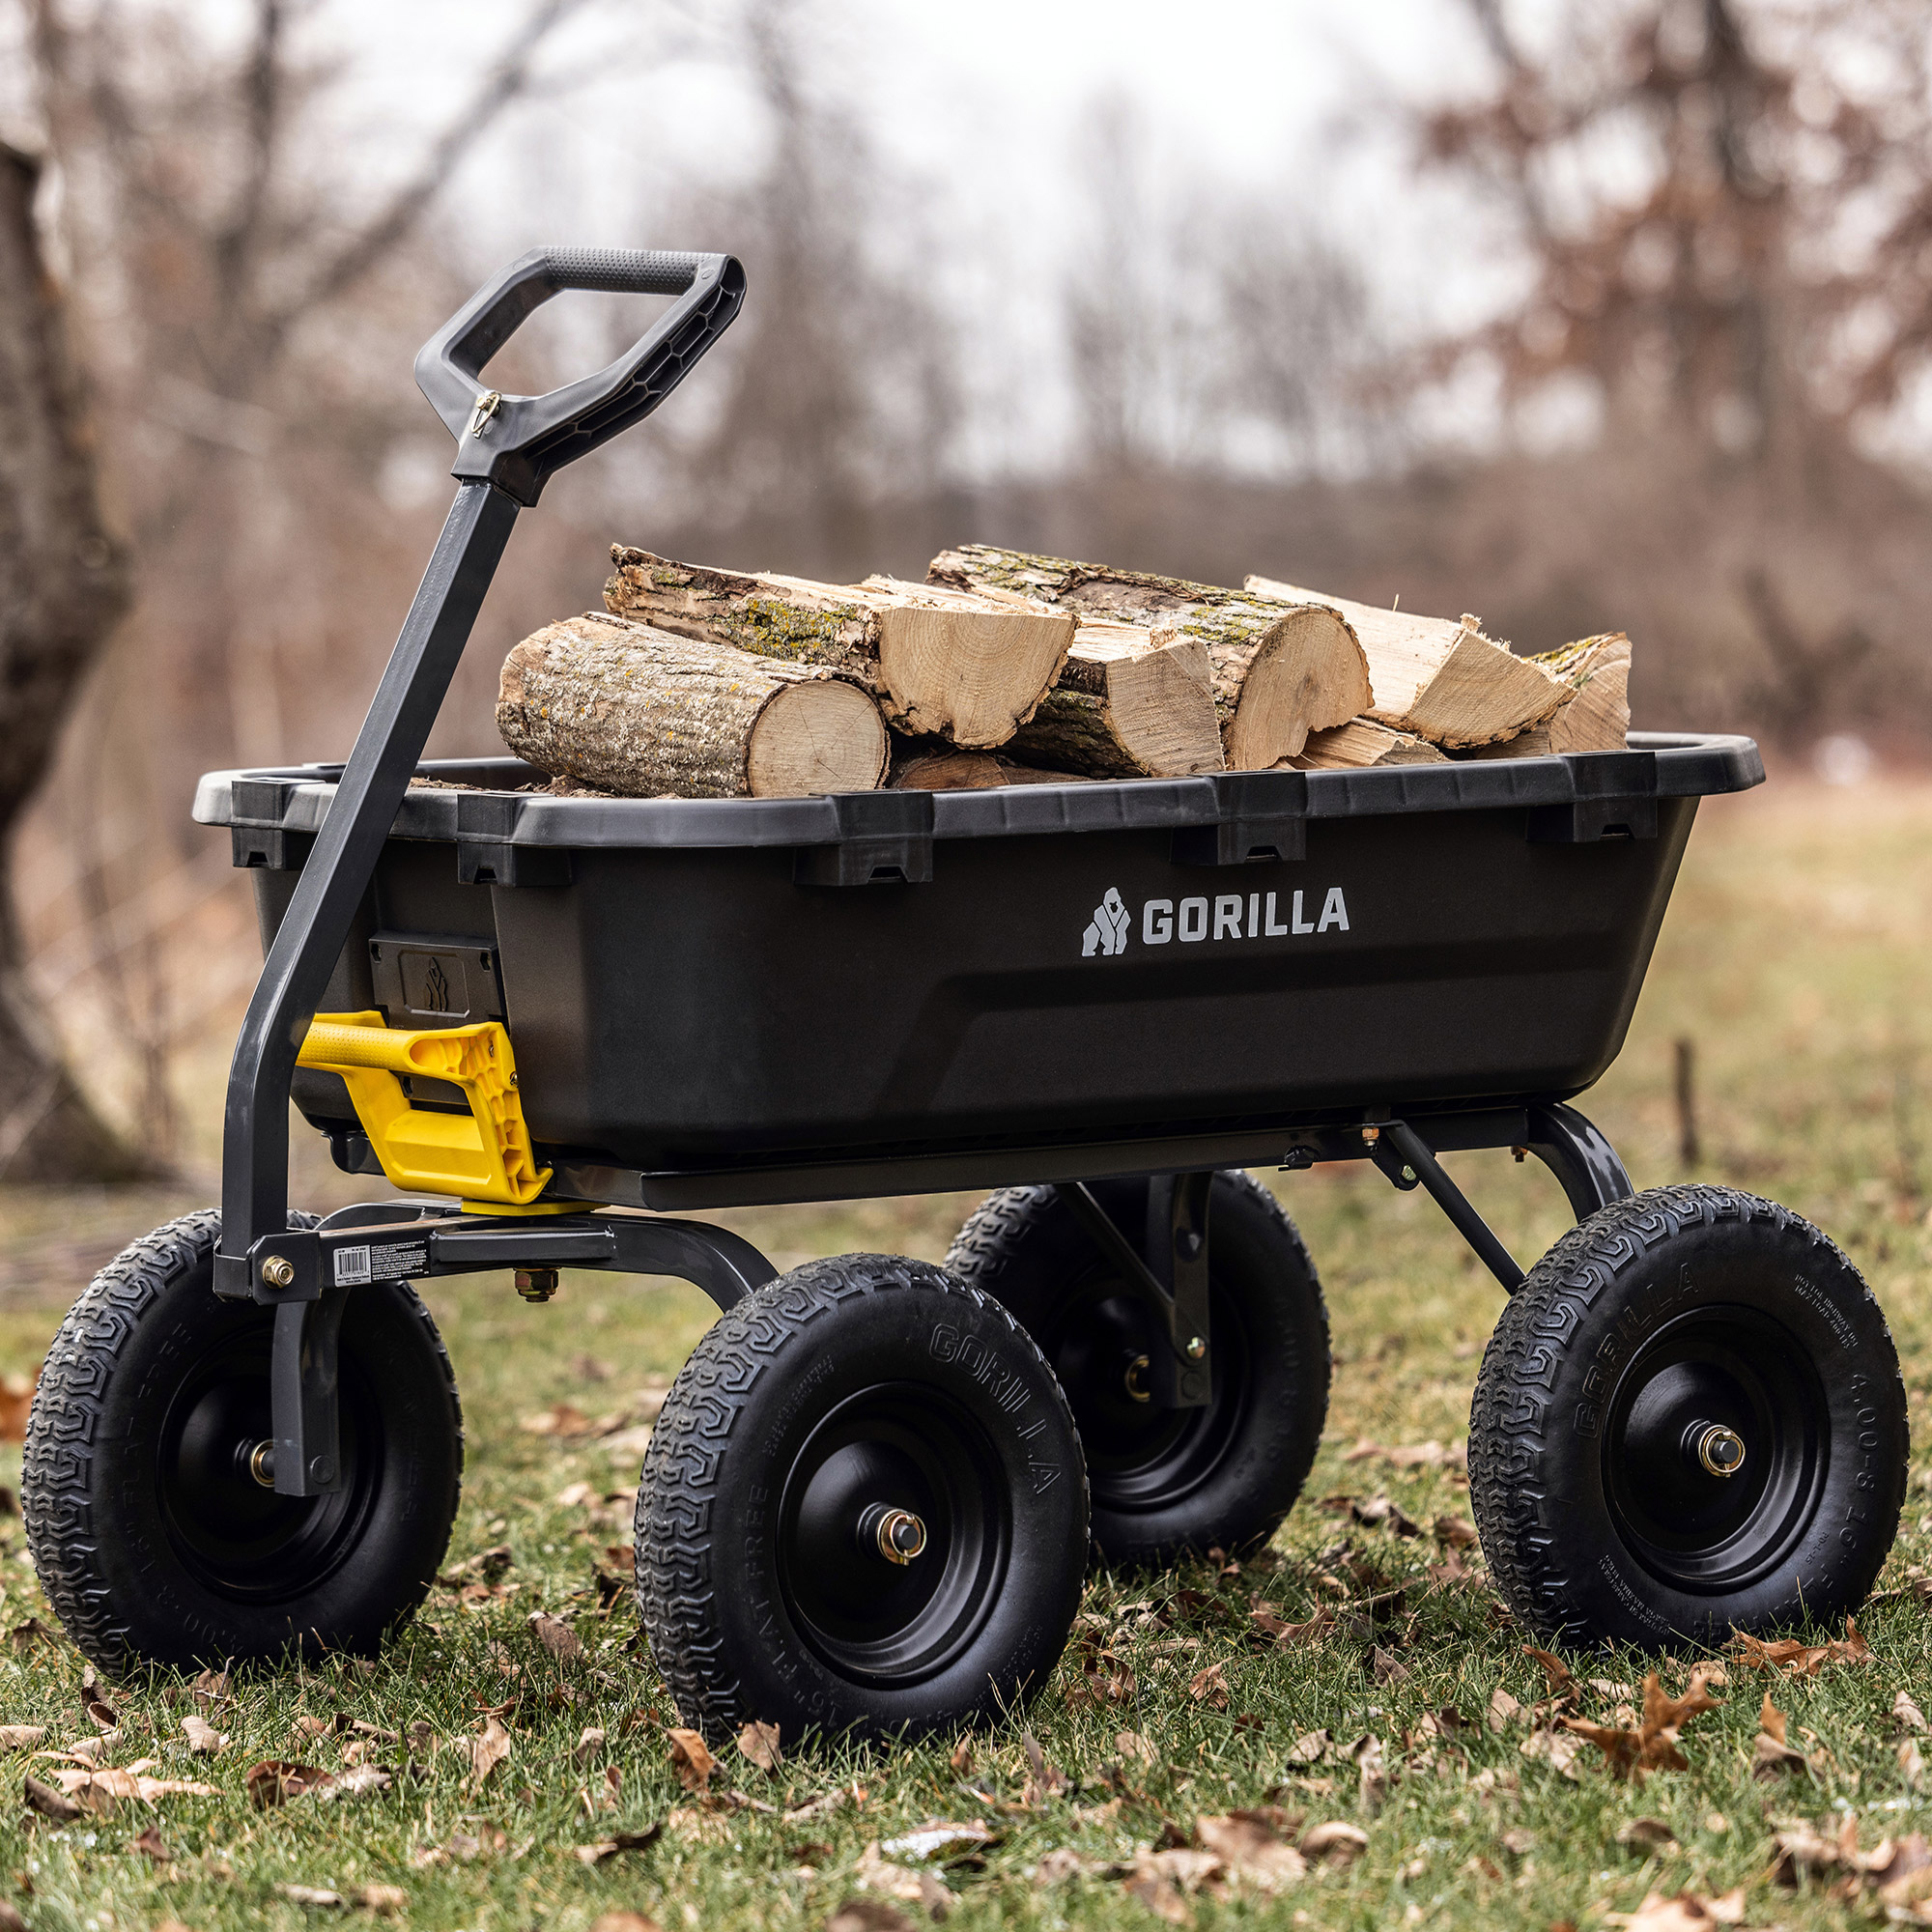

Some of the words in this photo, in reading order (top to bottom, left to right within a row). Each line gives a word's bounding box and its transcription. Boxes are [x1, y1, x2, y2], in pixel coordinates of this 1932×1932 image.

[1142, 887, 1350, 945] GORILLA
[138, 1321, 192, 1400] FREE
[1574, 1262, 1700, 1437] GORILLA
[929, 1322, 1062, 1495] GORILLA
[1851, 1373, 1879, 1492] 4.00-8
[744, 1484, 769, 1581] FREE
